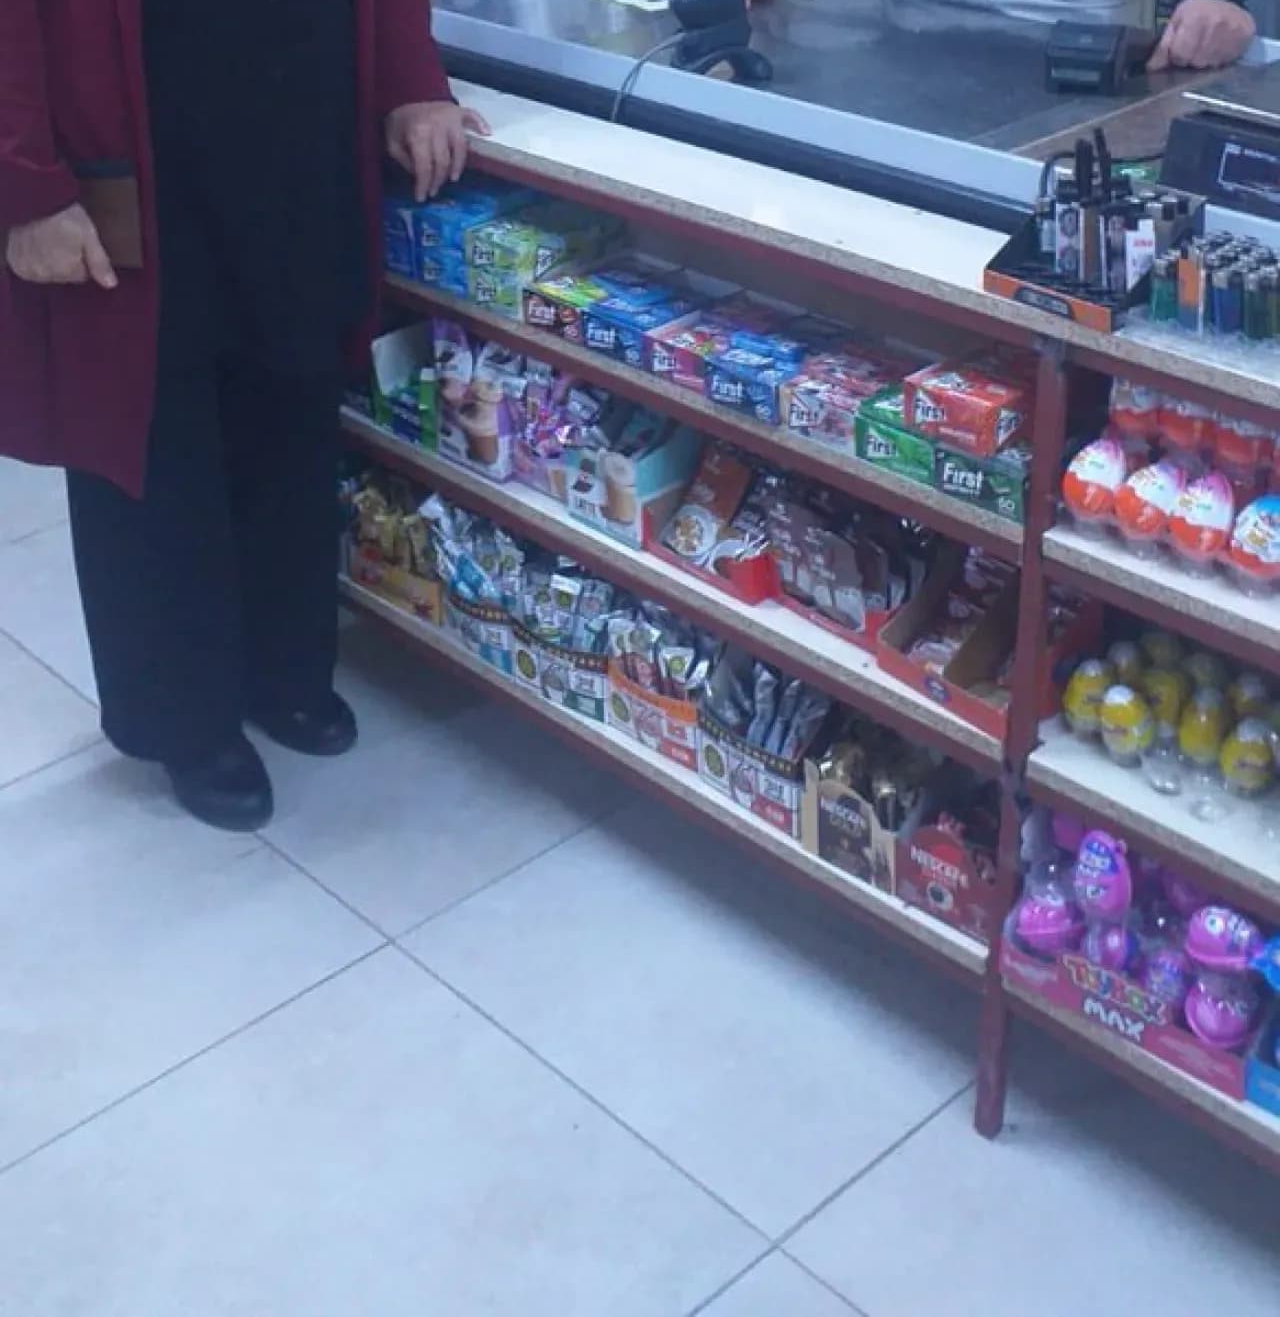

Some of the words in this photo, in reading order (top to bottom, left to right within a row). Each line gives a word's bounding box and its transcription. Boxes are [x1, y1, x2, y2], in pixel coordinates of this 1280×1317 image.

[528, 295, 556, 317] First
[588, 321, 616, 345] First
[712, 374, 743, 398] First
[943, 461, 983, 492] First
[1083, 995, 1144, 1043] MAX
